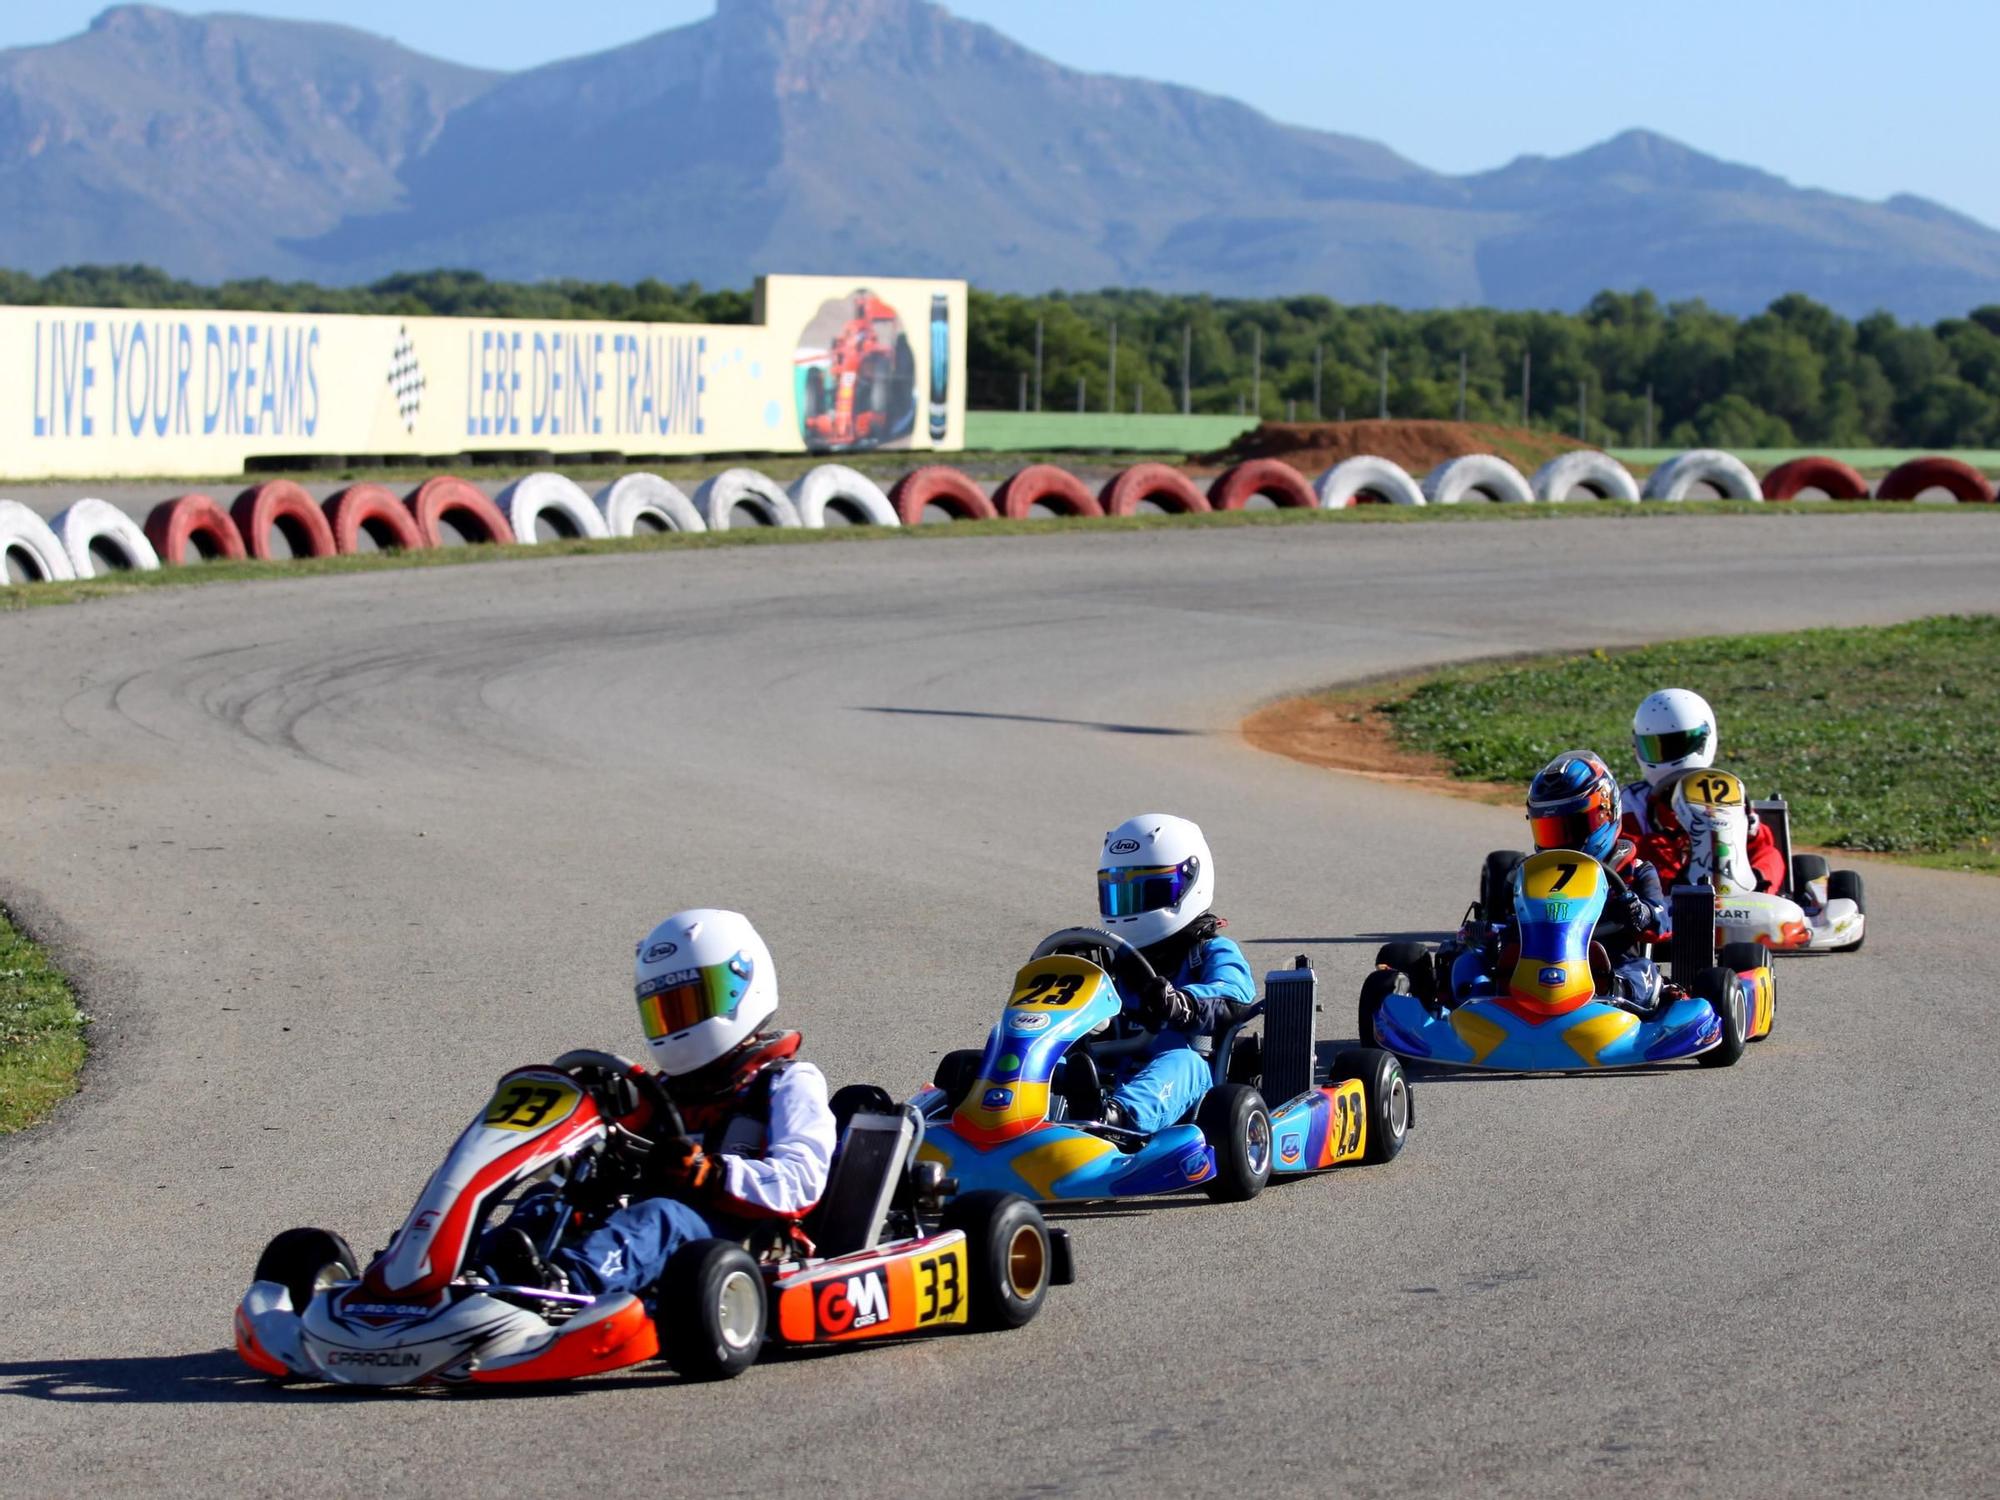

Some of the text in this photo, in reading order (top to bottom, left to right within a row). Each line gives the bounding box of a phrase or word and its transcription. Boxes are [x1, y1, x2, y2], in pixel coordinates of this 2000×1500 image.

[34, 320, 320, 437] LIVE YOUR DREAMS
[467, 330, 521, 435] LEBE
[531, 331, 603, 435] DEINE
[1696, 779, 1730, 803] 12
[1549, 863, 1578, 892] 7
[1715, 909, 1751, 919] KART
[1012, 974, 1085, 1006] 23
[483, 1086, 562, 1127] 33
[1335, 1092, 1362, 1157] 23
[818, 1272, 889, 1333] GM
[919, 1251, 961, 1323] 33
